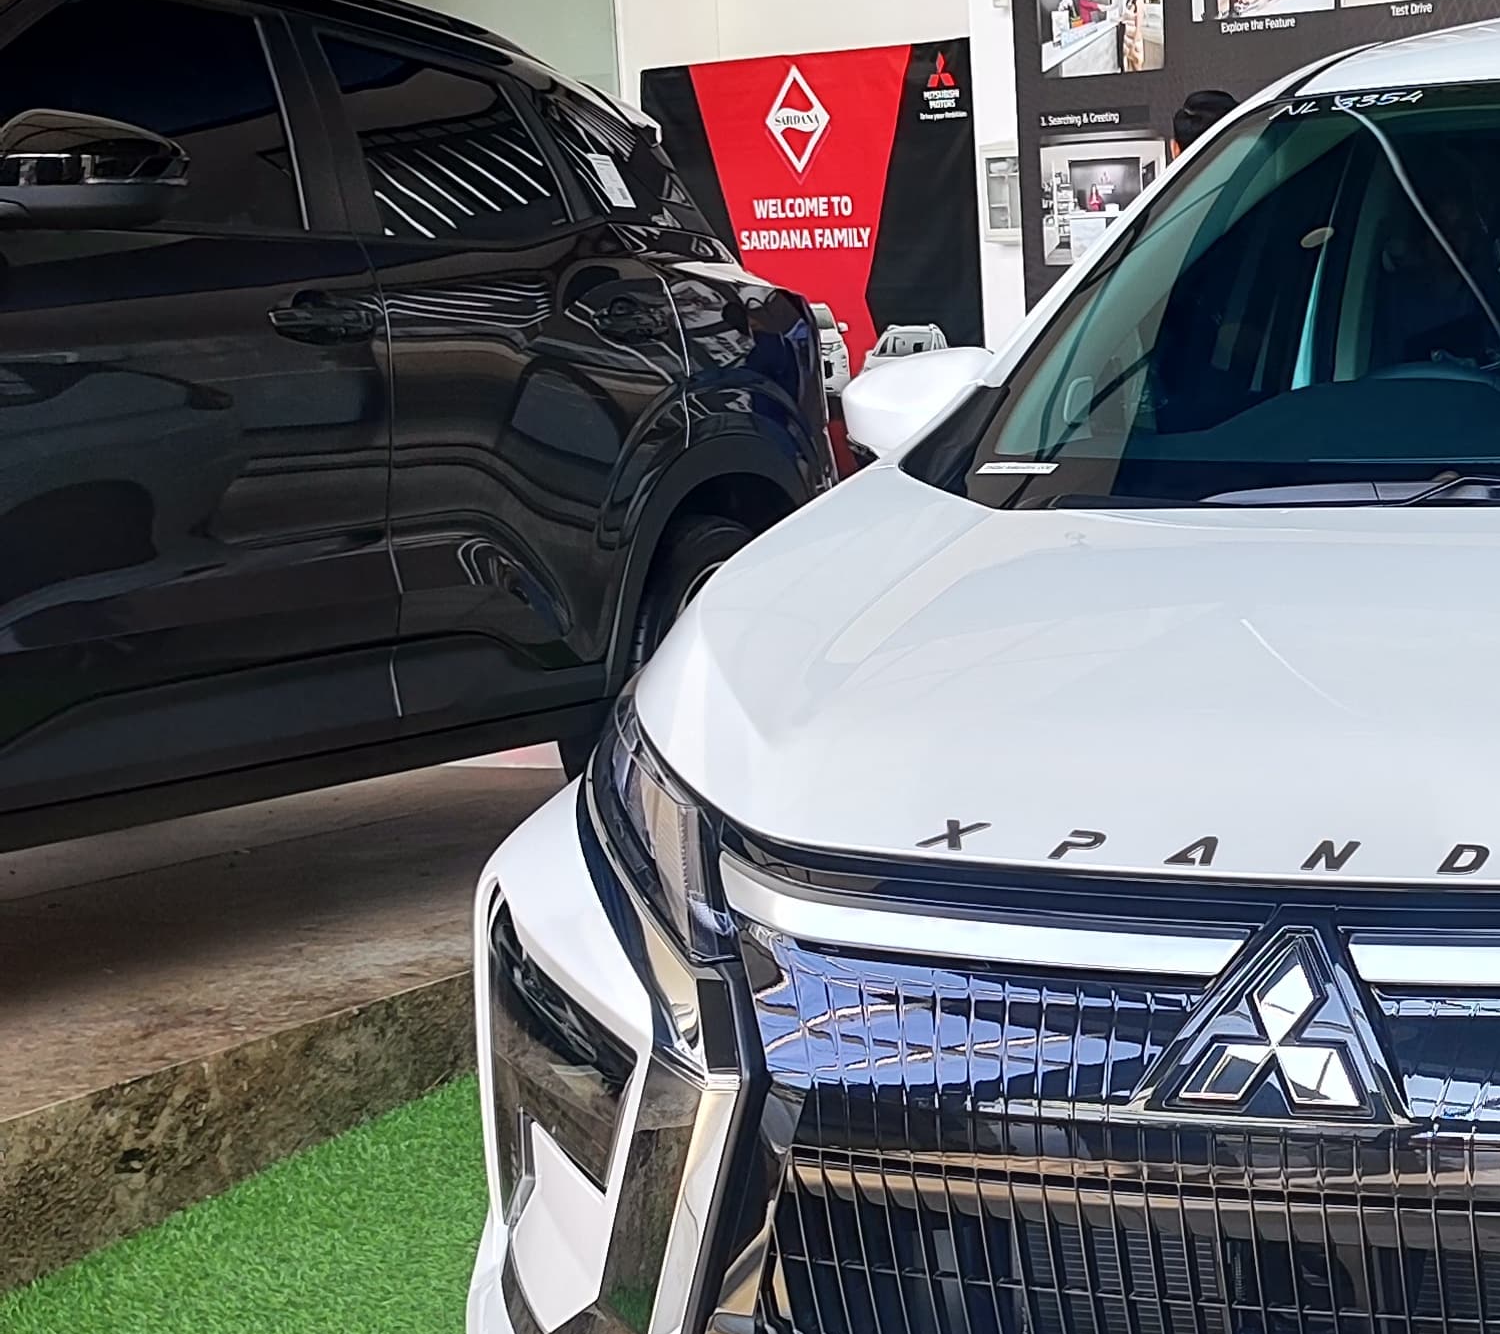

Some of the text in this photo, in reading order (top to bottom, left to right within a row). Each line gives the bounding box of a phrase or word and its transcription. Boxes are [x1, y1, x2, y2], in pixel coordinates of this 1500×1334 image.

[1391, 2, 1433, 17] Test Drive
[1220, 17, 1296, 34] Explore the Feature
[774, 114, 820, 126] SARDANA
[1048, 114, 1082, 127] Searching
[1082, 113, 1089, 124] &
[1089, 112, 1120, 124] Greeting
[752, 195, 853, 220] WELCOME TO
[740, 227, 872, 251] SARDANA FAMILY
